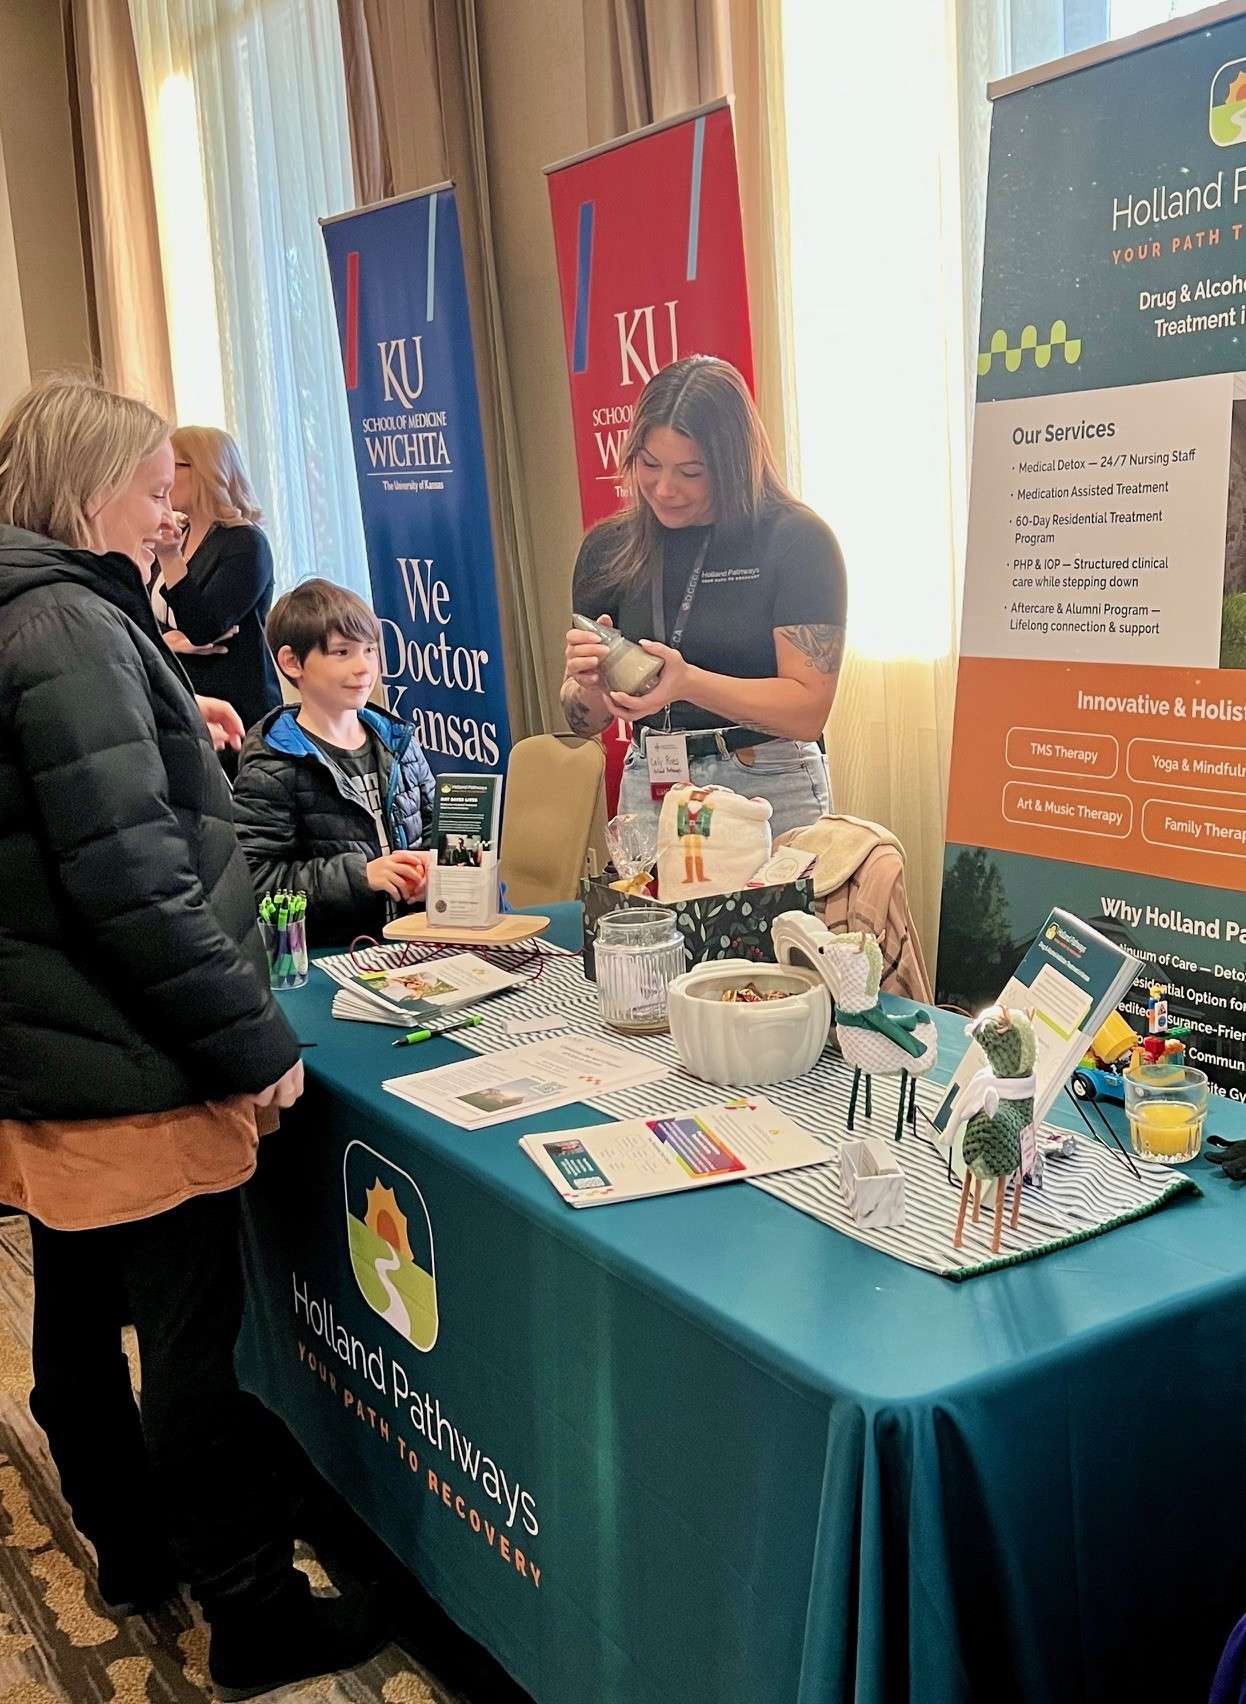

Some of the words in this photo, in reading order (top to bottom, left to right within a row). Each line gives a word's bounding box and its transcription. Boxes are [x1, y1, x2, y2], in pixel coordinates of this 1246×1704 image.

[1112, 171, 1223, 231] Holland
[1112, 241, 1161, 265] YOUR
[1172, 228, 1220, 253] PATH
[1140, 290, 1177, 310] Drug
[1180, 284, 1191, 303] &
[1194, 274, 1246, 301] Alcoh
[1154, 307, 1237, 338] Treatment
[614, 300, 679, 386] KU
[377, 336, 425, 409] KU
[363, 416, 396, 433] SCHOOL
[397, 415, 407, 430] OF
[408, 411, 448, 429] MEDICINE
[1012, 427, 1042, 445] Our
[1045, 420, 1116, 442] Services
[364, 431, 451, 468] WICHITA
[1019, 460, 1055, 473] Medical
[1057, 459, 1085, 471] Detox
[1100, 454, 1127, 468] 24/7
[1129, 452, 1169, 466] Nursing
[1172, 448, 1196, 462] Staff
[1017, 487, 1069, 500] Medication
[1071, 484, 1114, 497] Assisted
[1116, 481, 1169, 495] Treatment
[1016, 515, 1051, 528] 60-Day
[1052, 512, 1107, 525] Residential
[1109, 510, 1162, 523] Treatment
[1015, 532, 1055, 546] Program
[1013, 559, 1034, 570] PHP
[1035, 559, 1041, 570] &
[1044, 559, 1061, 570] IOP
[1073, 557, 1129, 569] Structured
[1132, 556, 1168, 569] clinical
[396, 557, 451, 624] We
[1012, 578, 1033, 587] care
[1035, 576, 1060, 587] while
[1062, 576, 1106, 590] stepping
[1109, 576, 1139, 588] down
[1010, 601, 1055, 614] Aftercare
[1056, 603, 1063, 614] &
[1065, 603, 1101, 614] Alumni
[1104, 603, 1148, 618] Program
[1010, 619, 1048, 634] Lifelong
[1050, 621, 1106, 633] connection
[1109, 621, 1116, 633] &
[1119, 622, 1160, 636] support
[379, 618, 489, 694] Doctor
[1077, 690, 1170, 716] Innovative
[1173, 697, 1187, 718] &
[1030, 742, 1053, 756] TMS
[1054, 745, 1098, 764] Therapy
[1152, 755, 1179, 773] Yoga
[1181, 758, 1190, 772] &
[1016, 798, 1033, 810] Art
[1034, 800, 1042, 812] &
[1044, 801, 1075, 816] Music
[1077, 805, 1123, 826] Therapy
[1164, 817, 1202, 838] Family
[1101, 896, 1142, 928] Why
[1146, 905, 1220, 940] Holland
[1158, 954, 1171, 966] of
[1171, 955, 1198, 973] Care
[1214, 964, 1246, 983] Deto
[1186, 988, 1227, 1009] Option
[292, 1272, 386, 1395] Holland
[392, 1360, 539, 1536] Pathways
[298, 1341, 338, 1392] YOUR
[344, 1389, 390, 1442] PATH
[398, 1436, 418, 1473] TO
[428, 1469, 542, 1588] RECOVERY
